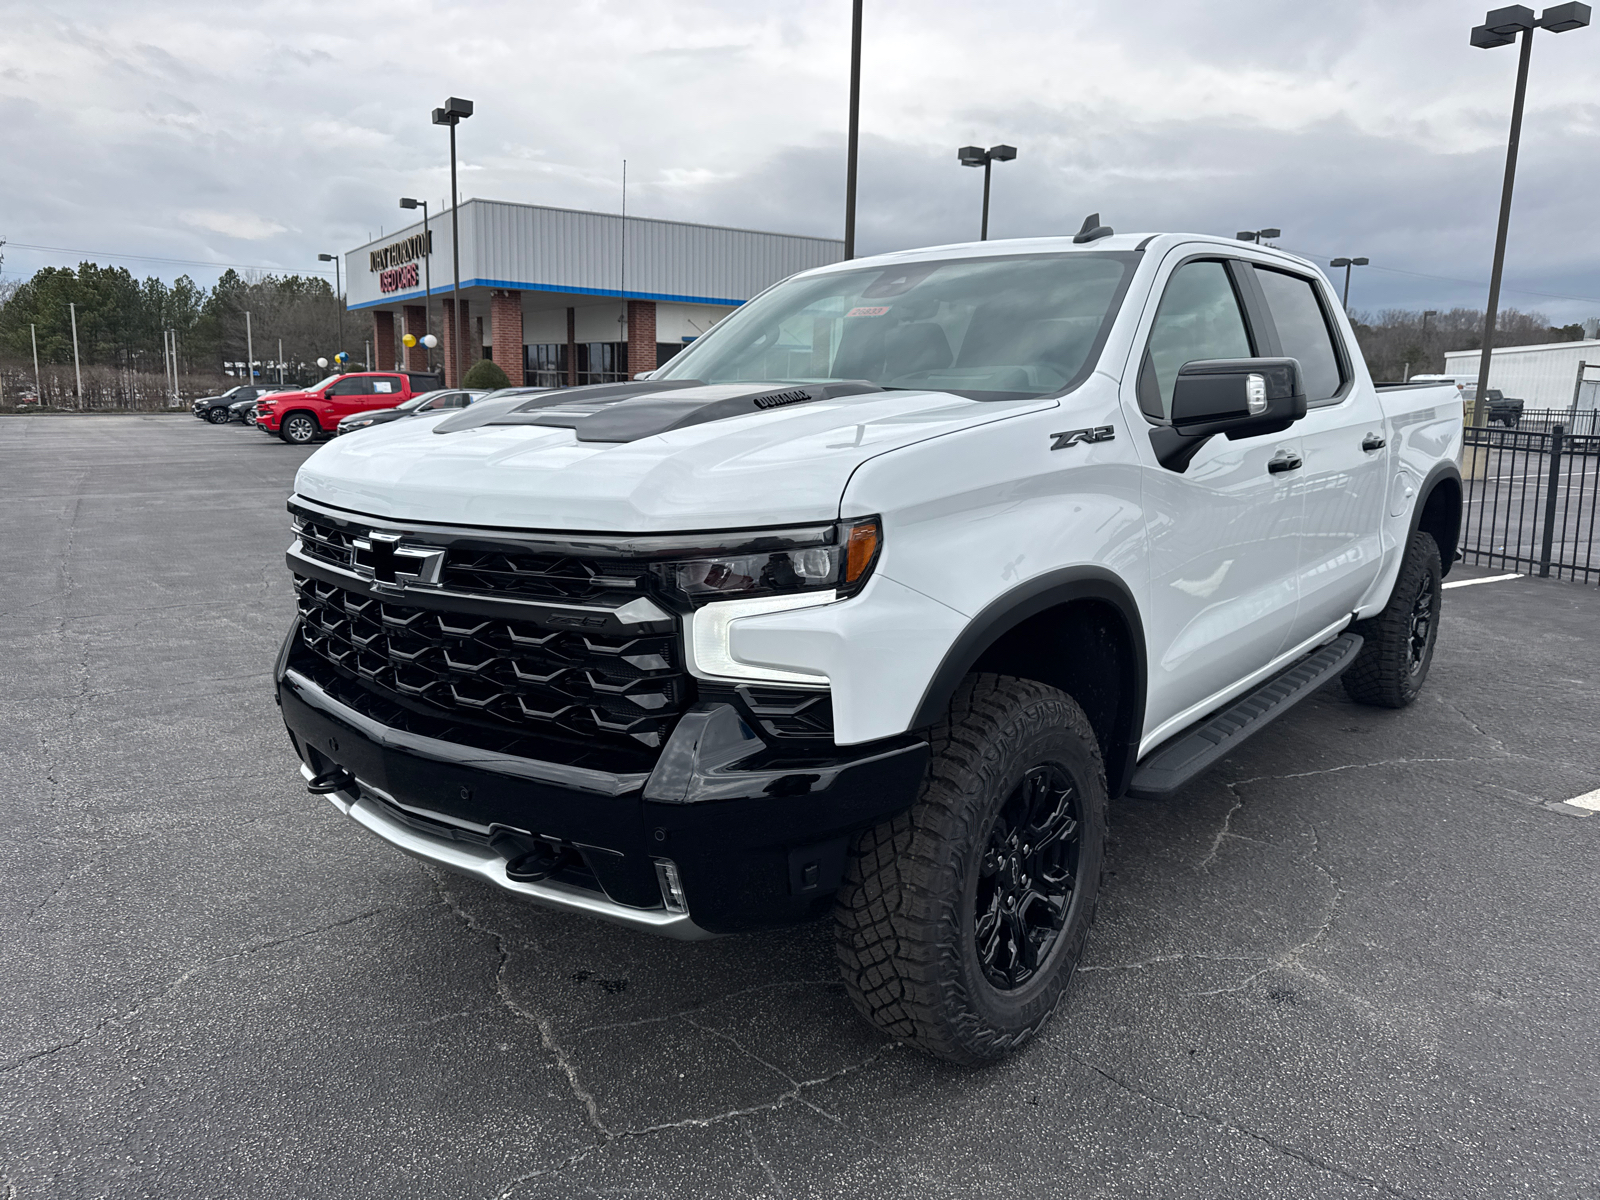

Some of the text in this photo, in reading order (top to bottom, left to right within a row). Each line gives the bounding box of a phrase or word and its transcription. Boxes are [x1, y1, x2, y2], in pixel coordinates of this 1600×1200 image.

[379, 263, 419, 293] USED CARS
[753, 390, 813, 410] DURAMAX
[1049, 424, 1116, 452] ZR2
[1019, 895, 1095, 1027] WRANGLER
